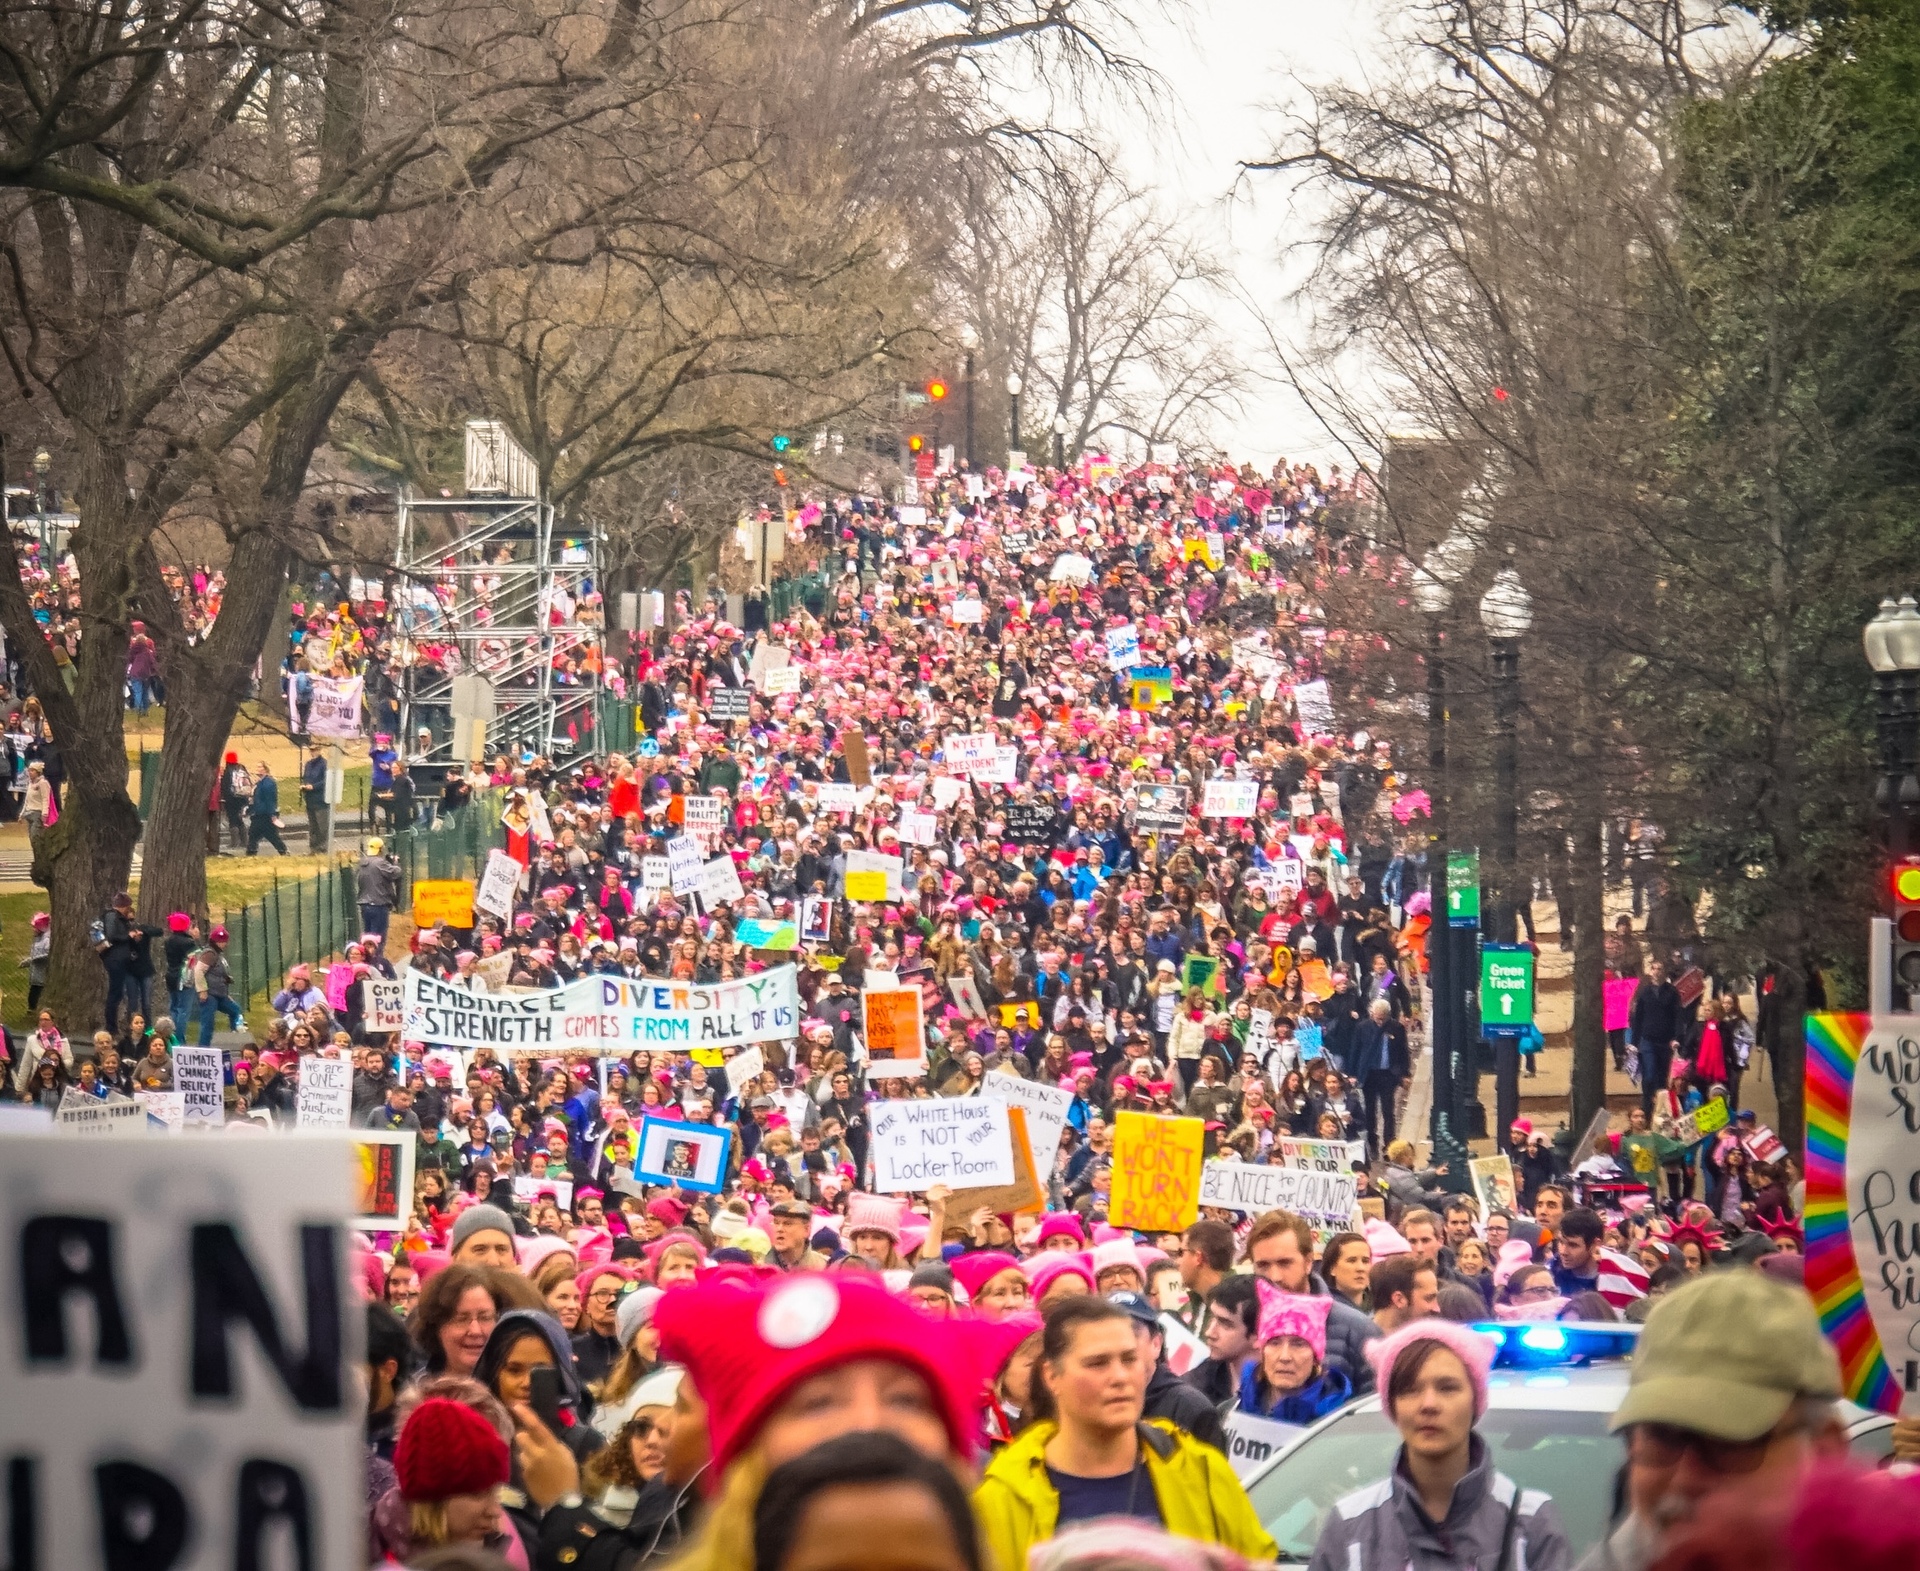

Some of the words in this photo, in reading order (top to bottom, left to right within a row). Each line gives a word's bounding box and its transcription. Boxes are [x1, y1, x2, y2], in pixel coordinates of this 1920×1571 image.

[952, 737, 984, 750] NYET
[965, 749, 979, 757] MY
[948, 757, 996, 771] PRESIDENT
[1489, 963, 1525, 977] Green
[1489, 976, 1526, 990] Ticket
[417, 978, 566, 1014] EMBRACE
[425, 1007, 552, 1043] STRENGTH
[565, 1014, 620, 1039] COMES
[633, 1016, 690, 1041] FROM
[701, 1014, 743, 1040] ALL
[752, 1010, 767, 1031] OF
[775, 1006, 792, 1027] US
[176, 1053, 217, 1067] CLIMATE
[303, 1059, 322, 1074] We
[324, 1063, 344, 1075] are
[178, 1068, 219, 1081] CHANGE?
[309, 1073, 344, 1088] ONE.
[180, 1080, 217, 1092] BELIEVE
[986, 1074, 1063, 1106] WOMEN'S
[184, 1092, 222, 1106] CIENCE!
[300, 1099, 344, 1115] Justice
[63, 1109, 98, 1123] RUSSIA
[110, 1105, 141, 1117] TRUMP
[876, 1114, 898, 1136] OUR
[904, 1104, 949, 1125] WHITE
[894, 1135, 907, 1147] IS
[921, 1126, 960, 1147] NOT
[966, 1120, 998, 1147] YOUR
[1143, 1117, 1177, 1146] WE
[1283, 1143, 1347, 1160] DIVERSITY
[667, 1166, 692, 1178] WTF?
[889, 1152, 951, 1181] Locker
[951, 1150, 999, 1177] Room
[1296, 1158, 1309, 1171] IS
[1315, 1158, 1339, 1173] OUR
[1124, 1170, 1192, 1201] TURN
[1202, 1167, 1228, 1201] BE
[1231, 1171, 1275, 1207] NICE
[1296, 1174, 1358, 1214] COUNTRY
[1121, 1199, 1187, 1231] BACK
[1324, 1217, 1354, 1233] WHAT
